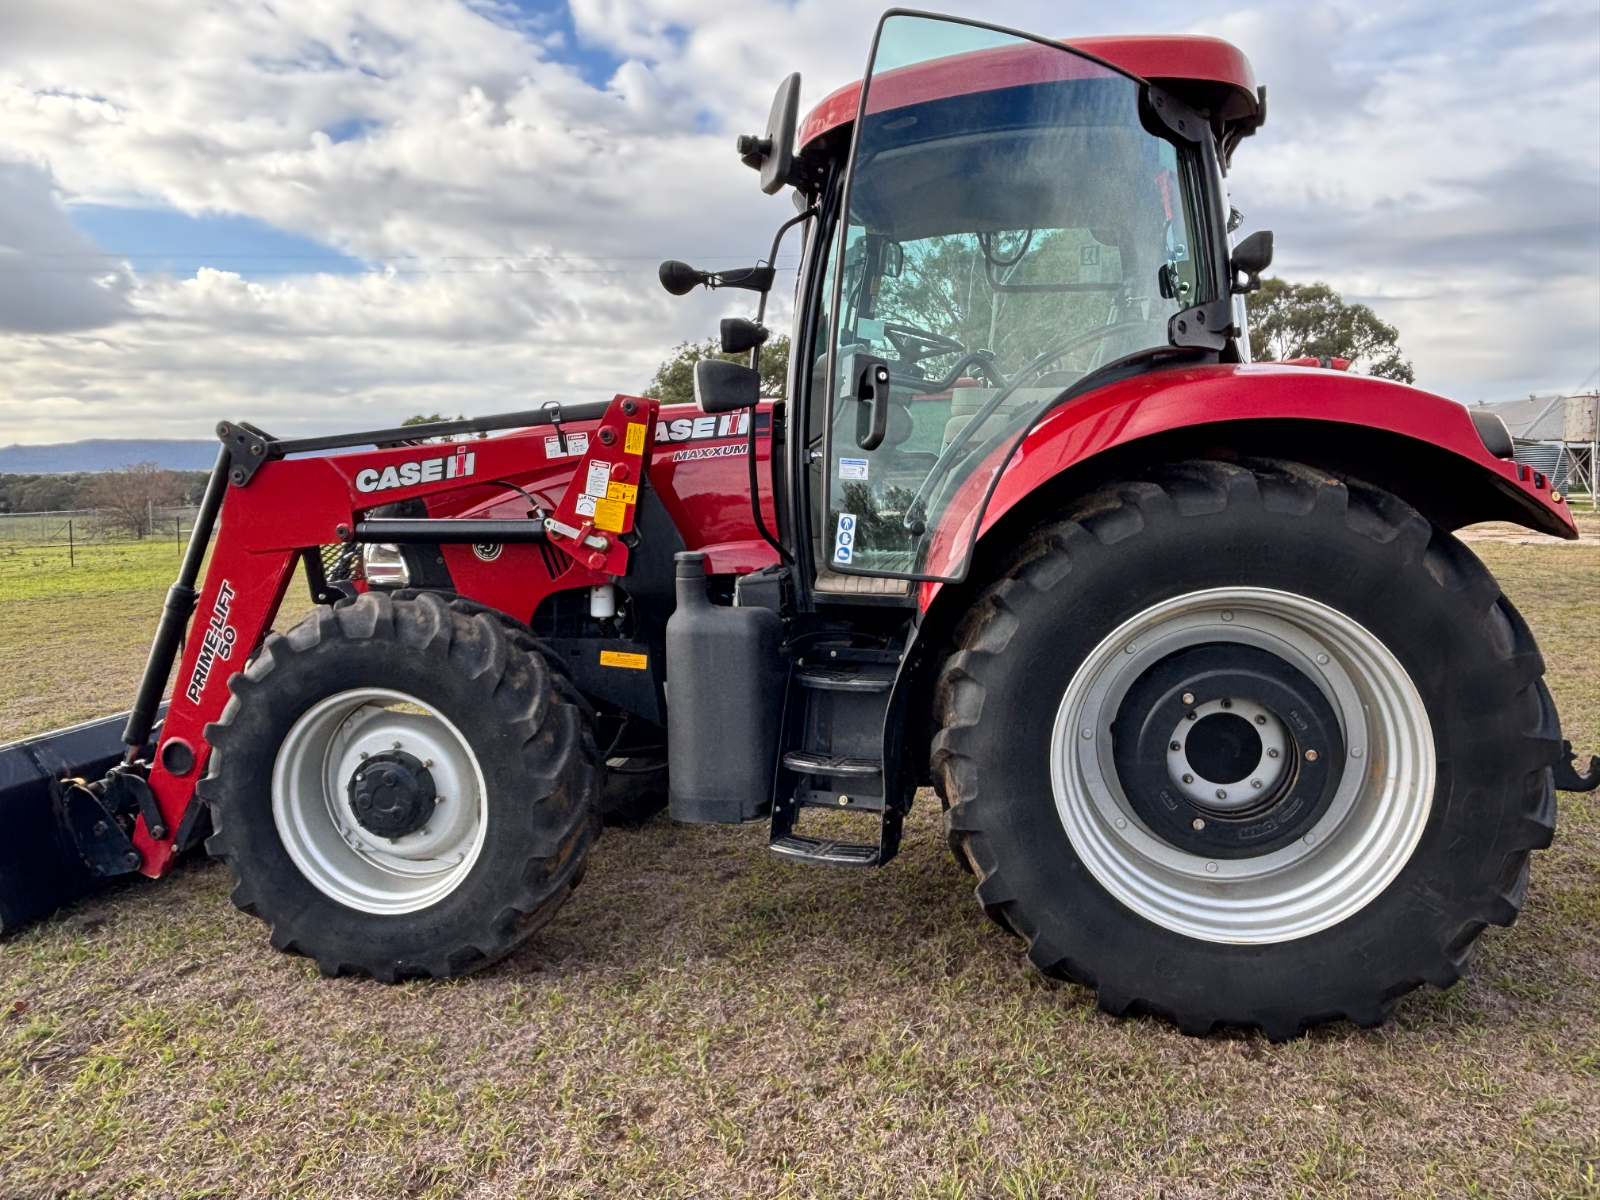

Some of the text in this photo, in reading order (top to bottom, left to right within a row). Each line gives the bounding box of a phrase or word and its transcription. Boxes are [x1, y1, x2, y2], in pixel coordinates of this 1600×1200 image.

[655, 416, 716, 442] ASE
[672, 444, 748, 462] MAXXUM
[356, 458, 443, 492] CASE
[186, 579, 236, 705] PRIME-LIFT
[217, 625, 237, 661] 50
